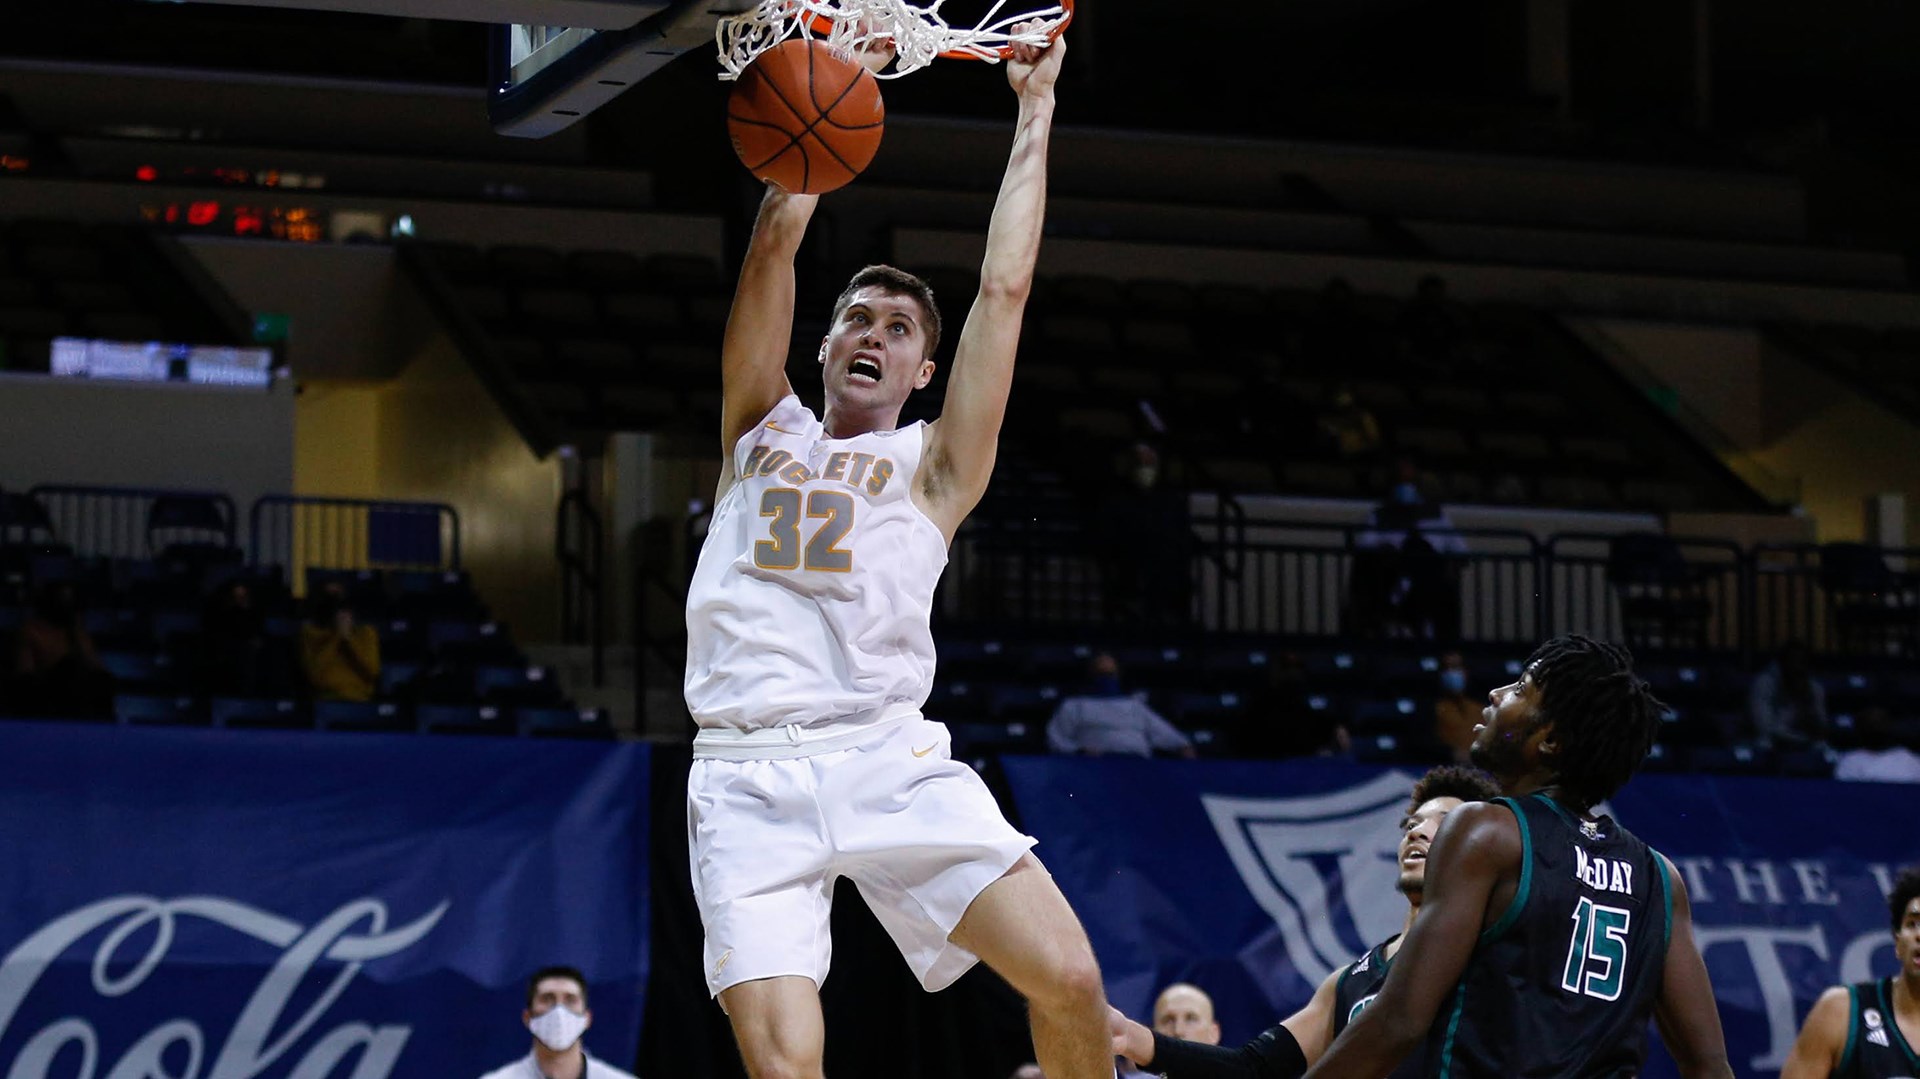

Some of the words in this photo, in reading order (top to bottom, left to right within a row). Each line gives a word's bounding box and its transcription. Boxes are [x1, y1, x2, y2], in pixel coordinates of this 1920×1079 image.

[742, 445, 894, 496] ROCETS
[754, 487, 855, 573] 32
[1574, 845, 1633, 895] McDAY
[1678, 856, 1840, 906] THE
[1561, 895, 1631, 1002] 15
